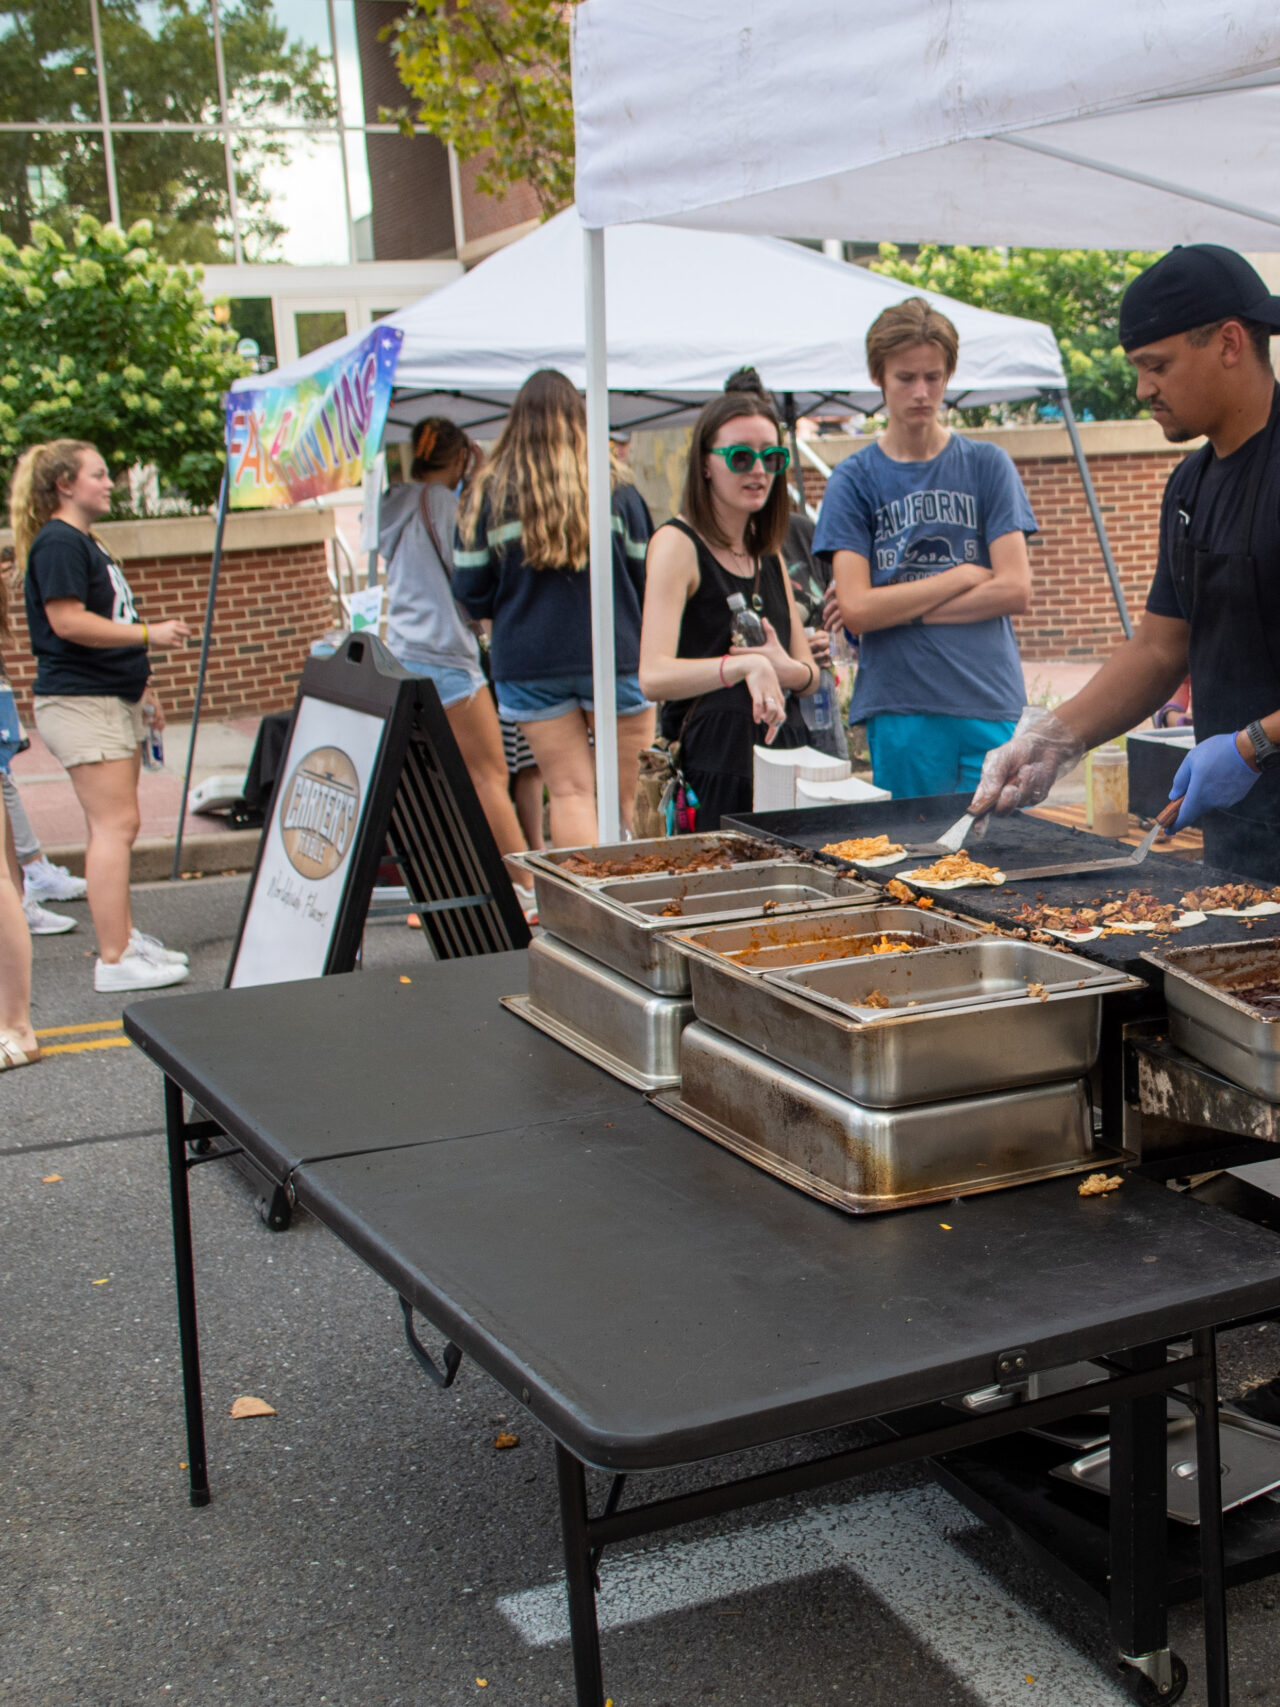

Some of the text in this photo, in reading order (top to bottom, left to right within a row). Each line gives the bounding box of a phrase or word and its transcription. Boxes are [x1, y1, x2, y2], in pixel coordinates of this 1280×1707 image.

[874, 490, 977, 542] CALIFORNI
[877, 549, 897, 570] 18
[284, 774, 358, 856] CARTER'S
[298, 832, 327, 864] TABLE
